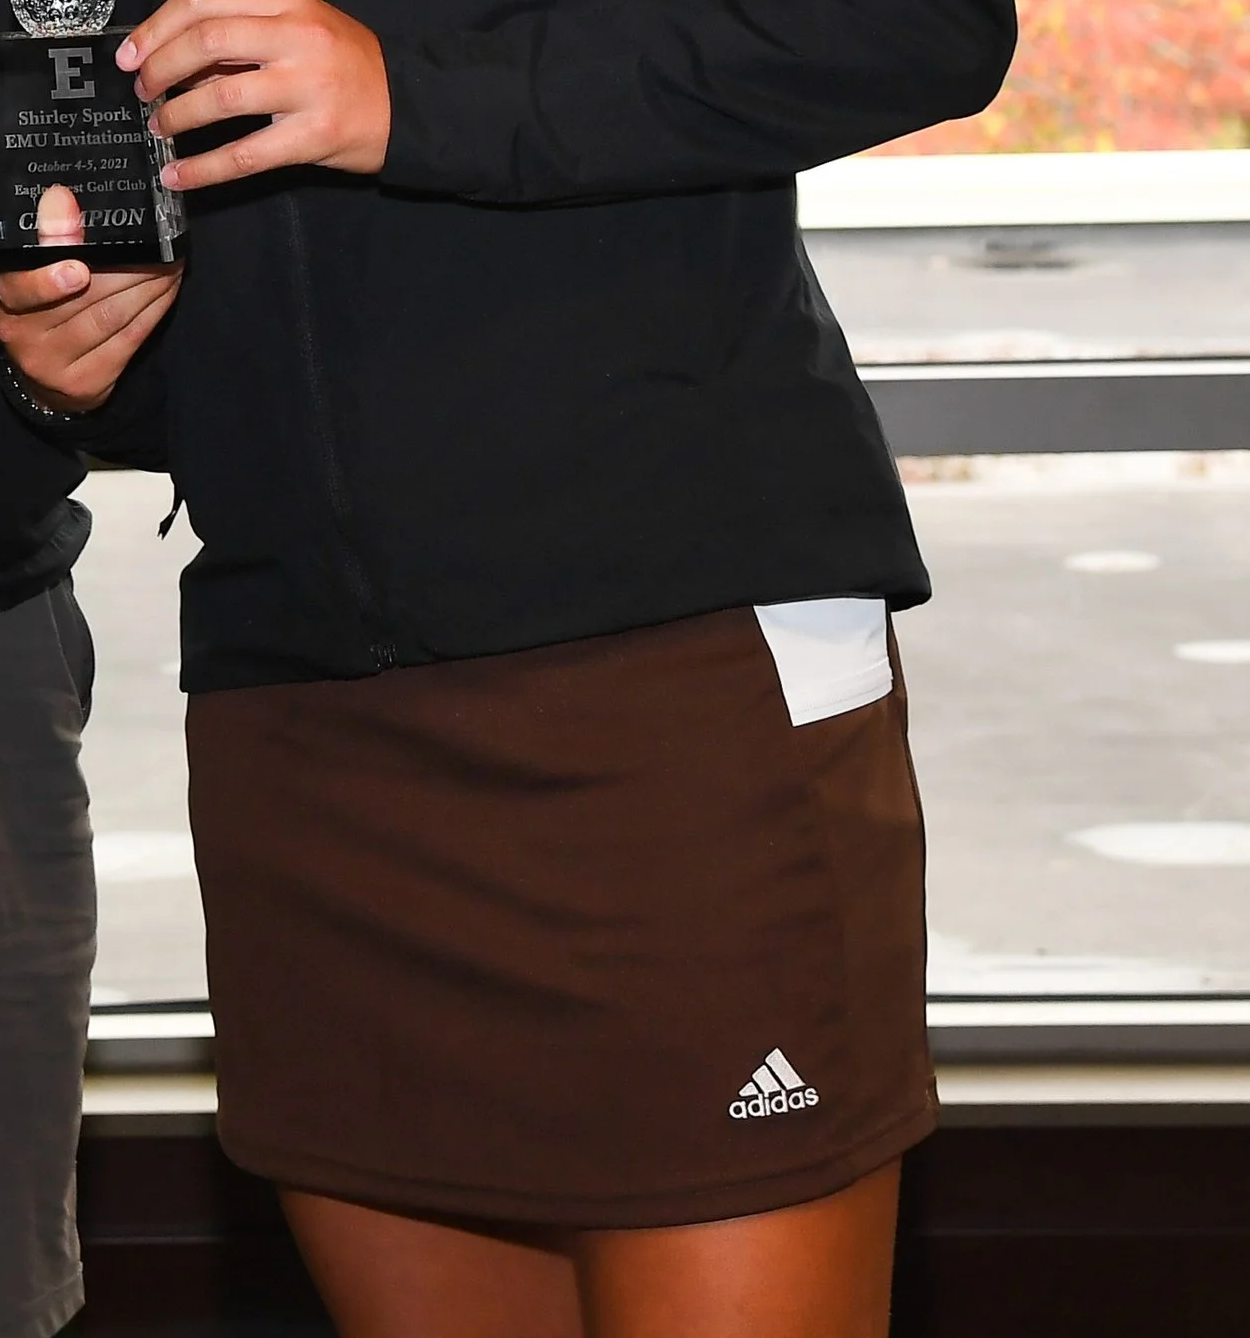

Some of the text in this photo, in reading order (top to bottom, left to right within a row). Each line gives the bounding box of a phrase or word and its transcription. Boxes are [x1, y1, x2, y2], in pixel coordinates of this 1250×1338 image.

[48, 47, 95, 99] E
[18, 106, 132, 128] Shirley Spork
[5, 132, 48, 148] EMU
[27, 158, 129, 173] October 4-5, 2021
[86, 181, 115, 193] Golf
[117, 179, 147, 191] Club
[19, 208, 146, 230] CPION
[729, 1087, 819, 1119] adidas
